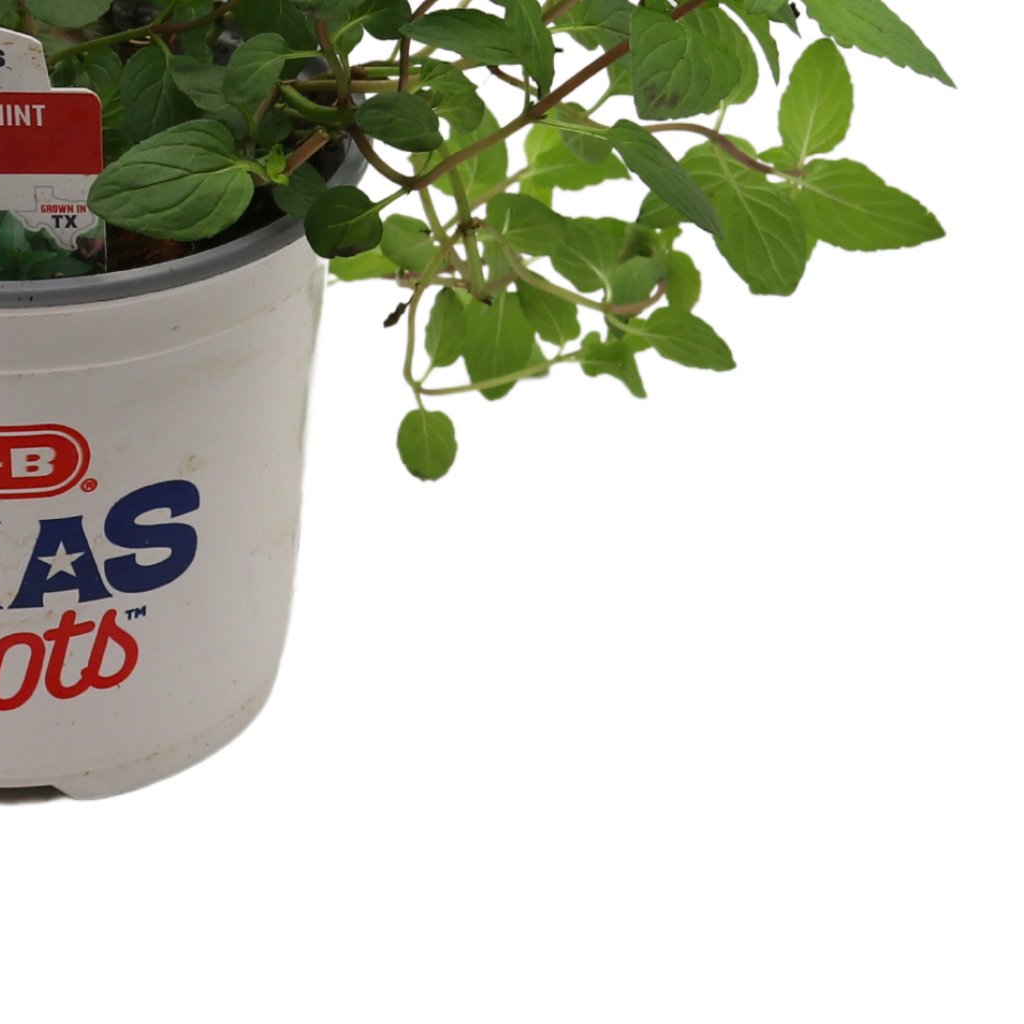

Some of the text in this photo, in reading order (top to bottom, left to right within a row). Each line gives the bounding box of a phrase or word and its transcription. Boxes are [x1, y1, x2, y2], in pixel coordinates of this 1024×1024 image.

[40, 204, 87, 214] GROWN IN
[51, 215, 78, 228] TX
